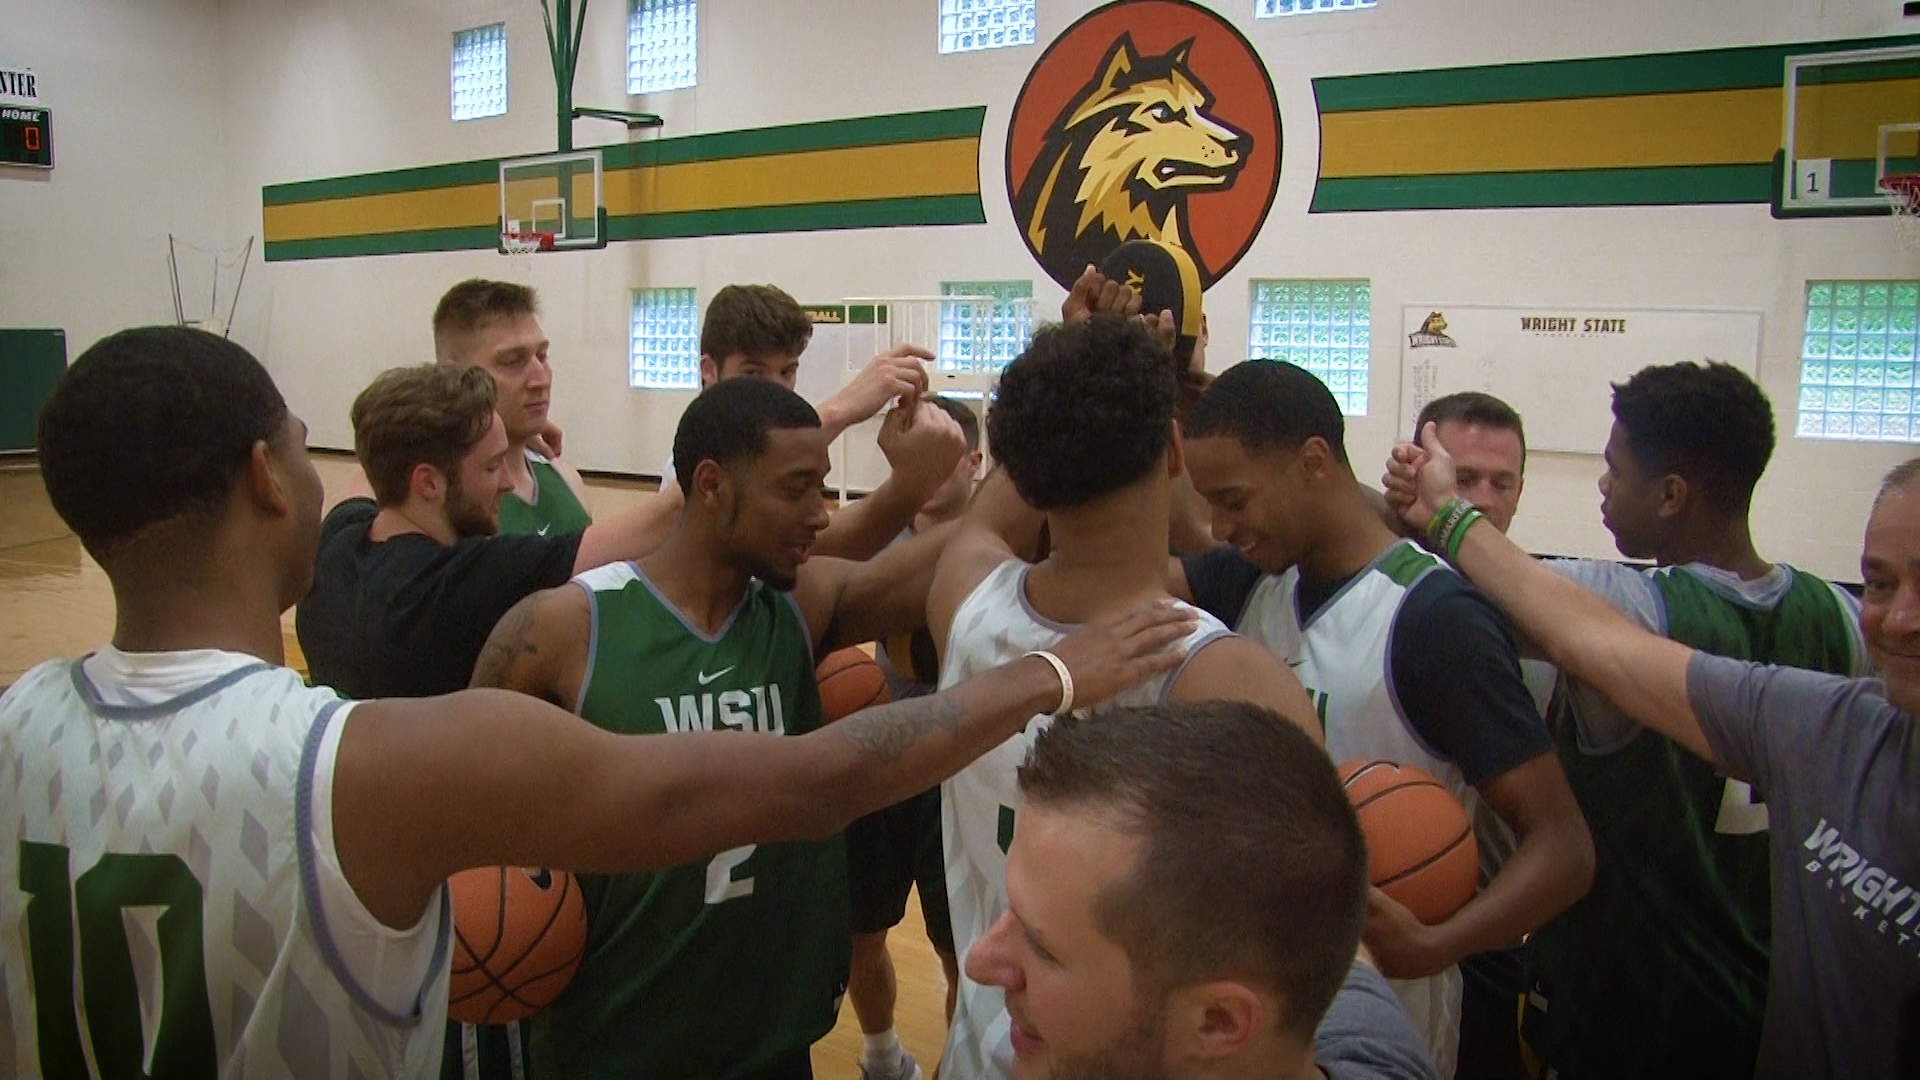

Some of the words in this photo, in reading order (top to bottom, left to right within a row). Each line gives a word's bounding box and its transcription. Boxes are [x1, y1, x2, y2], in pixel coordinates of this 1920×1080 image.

[2, 109, 40, 121] HOME
[25, 127, 40, 150] 0
[1806, 171, 1818, 193] 1
[804, 310, 841, 322] BALL
[1520, 317, 1577, 332] WRIGHT
[1583, 319, 1627, 333] STATE
[654, 683, 785, 736] WSU
[1804, 817, 1920, 926] WRIGHT
[18, 839, 218, 1080] 10
